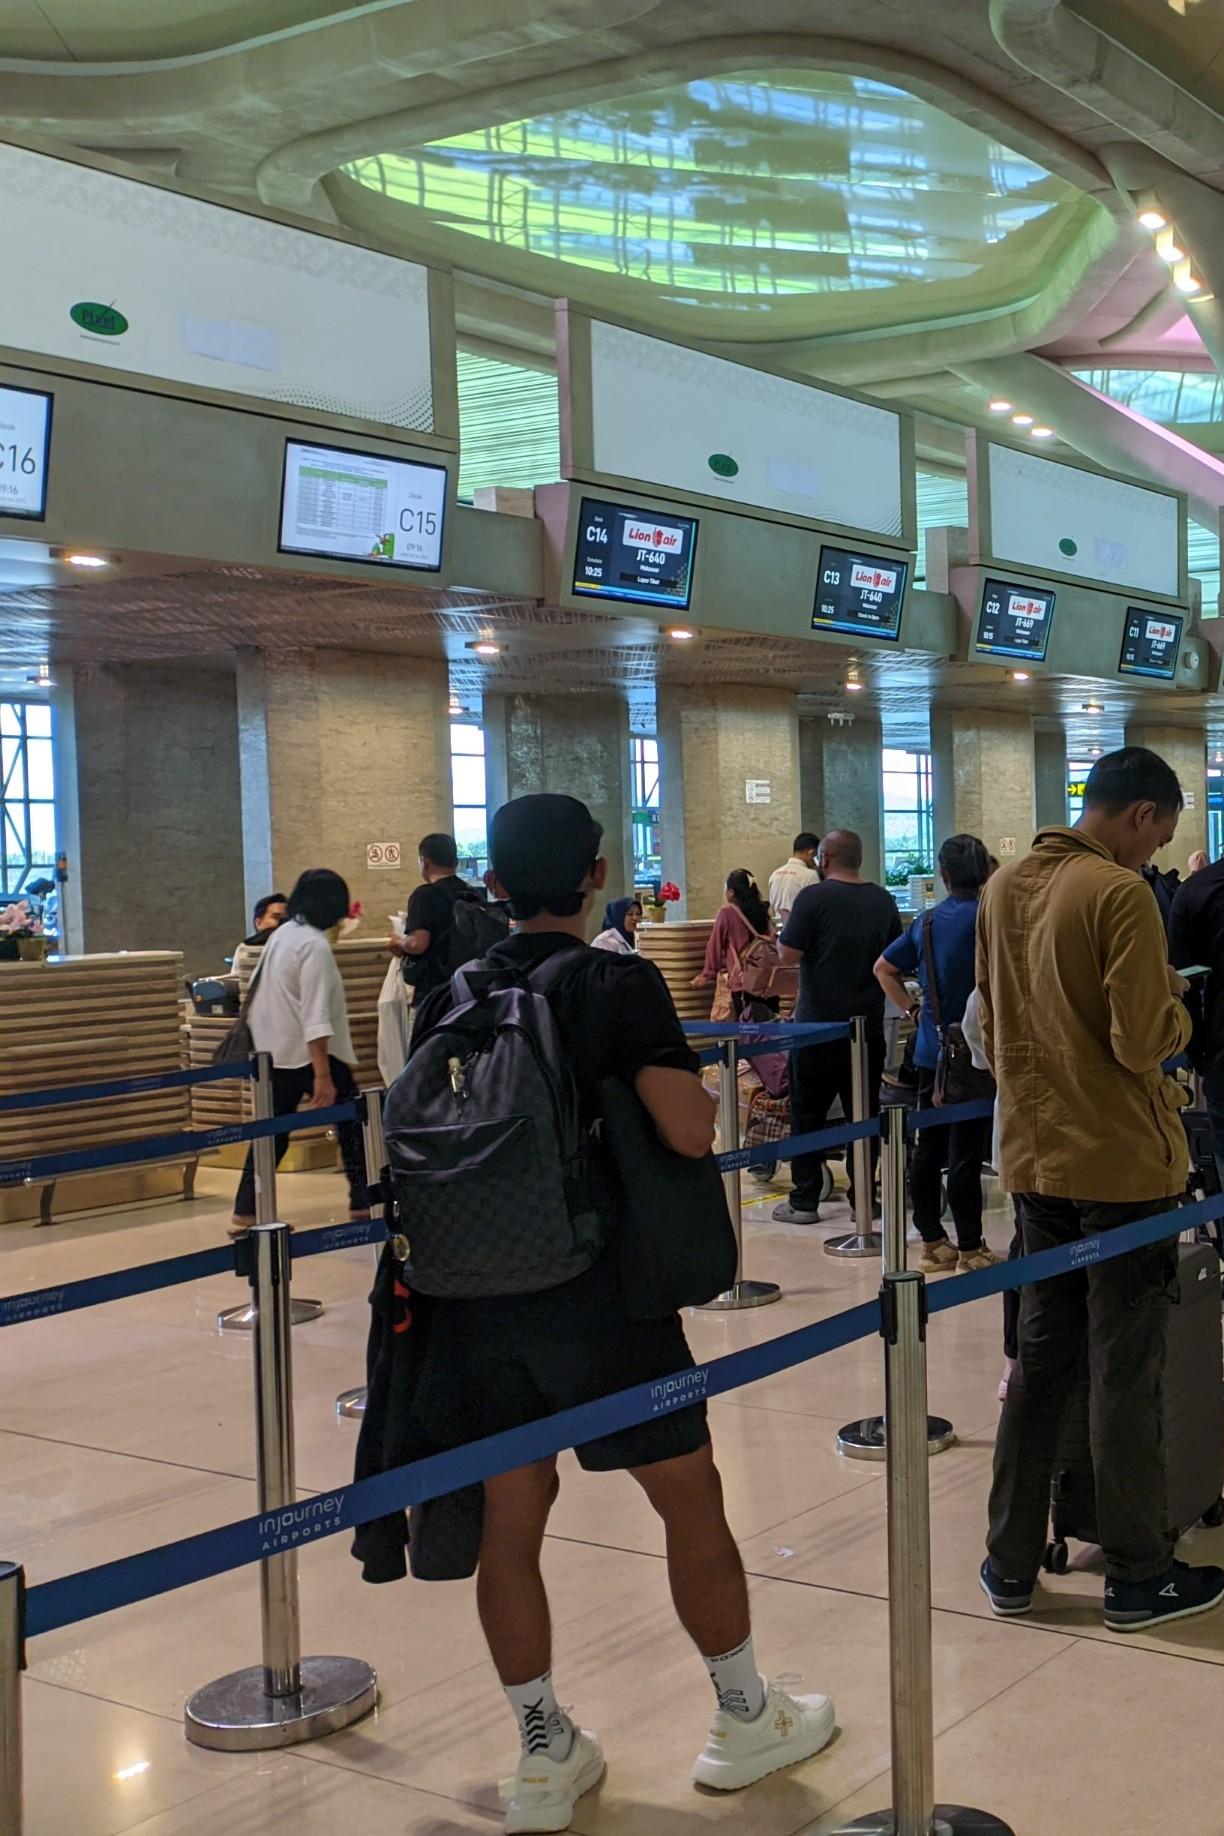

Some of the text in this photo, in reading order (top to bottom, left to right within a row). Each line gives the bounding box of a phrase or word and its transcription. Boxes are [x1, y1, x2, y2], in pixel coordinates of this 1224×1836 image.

[400, 508, 437, 535] C15
[586, 526, 608, 543] C14
[628, 528, 678, 546] Lion air
[636, 549, 666, 565] JT-640
[585, 566, 603, 577] 10:25
[824, 570, 840, 585] C13
[855, 570, 892, 586] Lion air
[860, 590, 882, 602] JT-640
[986, 601, 1000, 614] C12
[1012, 601, 1026, 611] Lion
[651, 1368, 709, 1400] injourney
[653, 1386, 706, 1412] AIRPORTS
[259, 1494, 345, 1535] injourney
[262, 1517, 341, 1551] AIRPORTS
